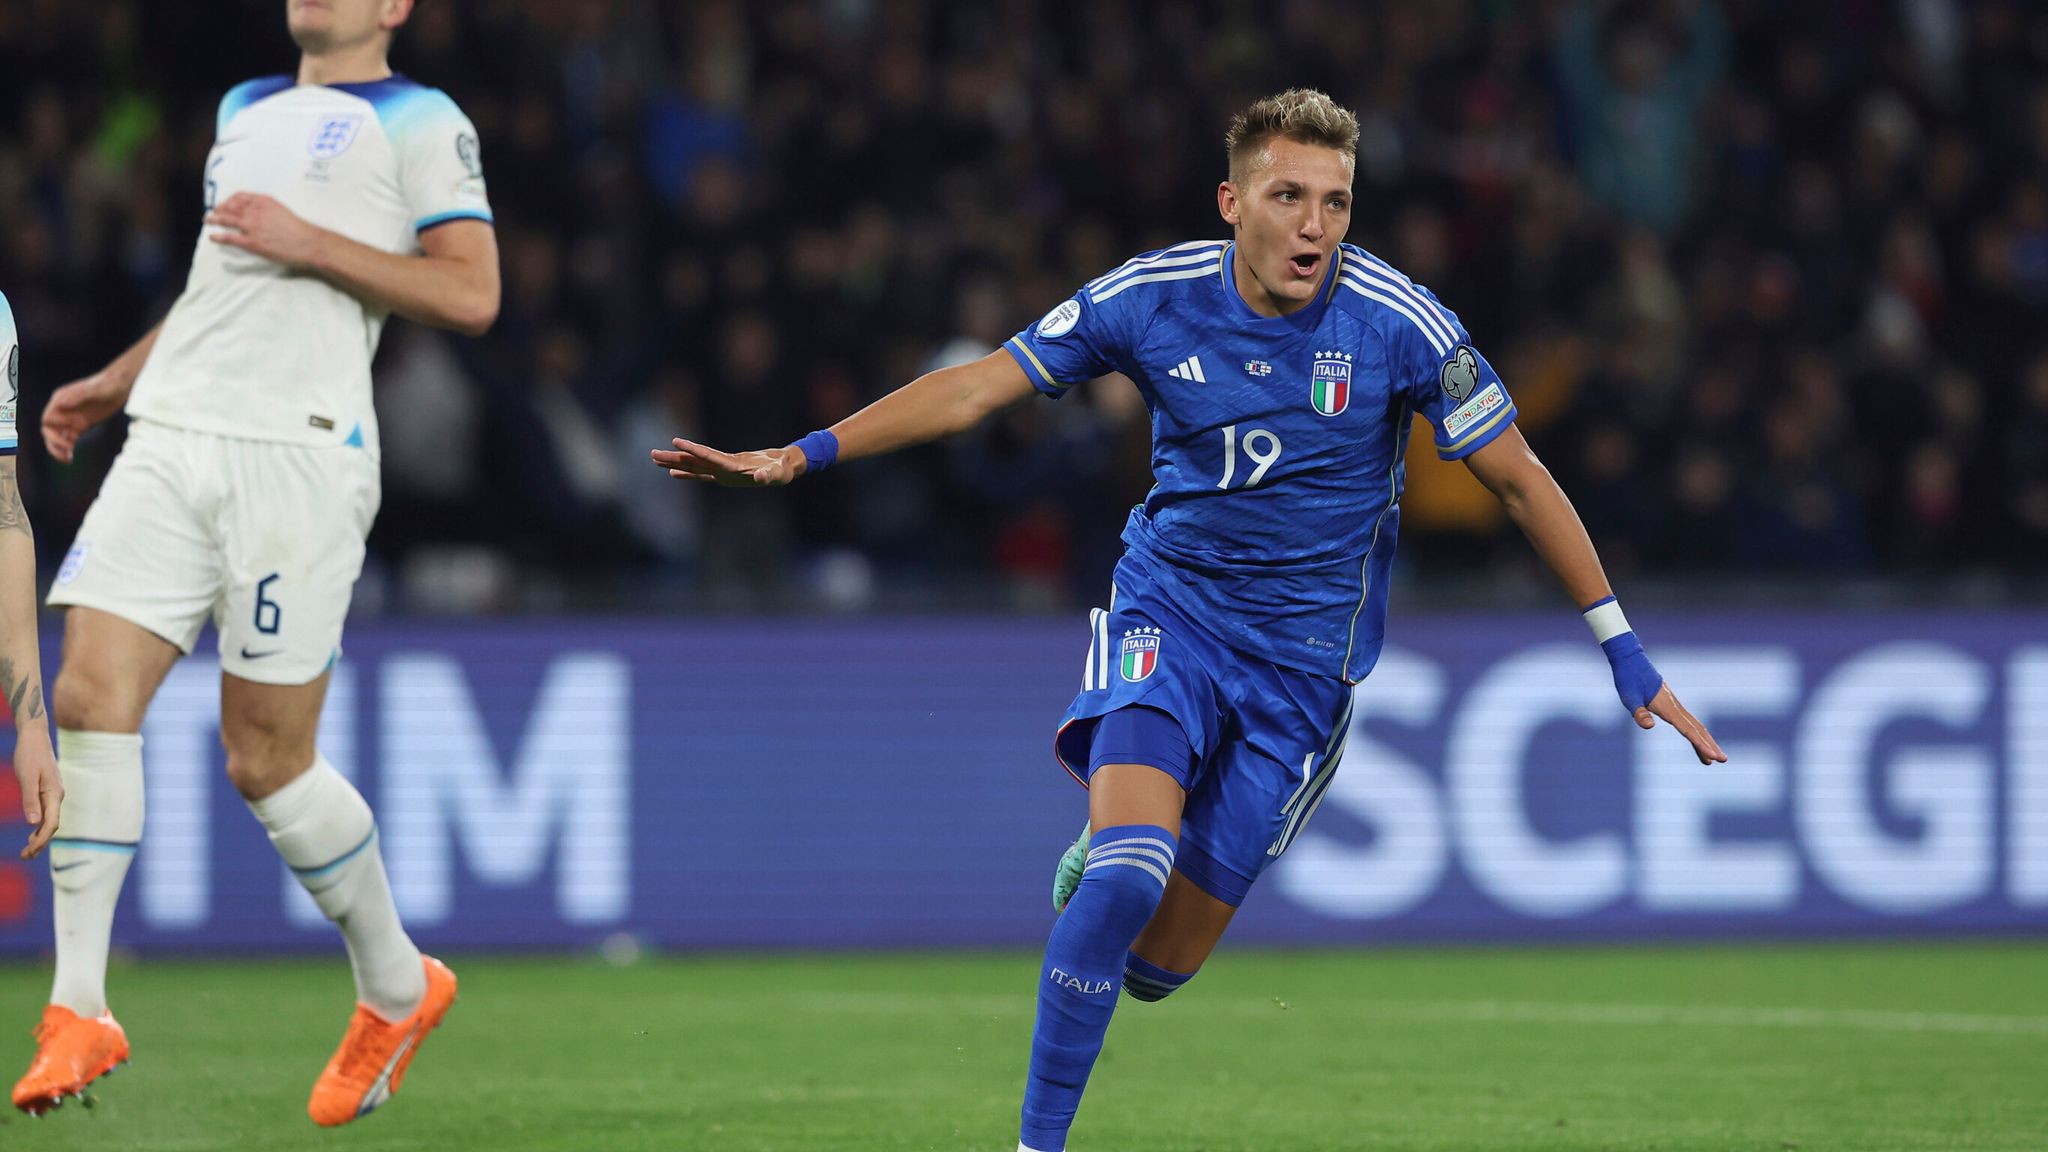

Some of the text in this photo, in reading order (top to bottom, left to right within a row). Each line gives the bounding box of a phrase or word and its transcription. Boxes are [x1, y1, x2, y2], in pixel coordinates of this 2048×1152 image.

[1315, 364, 1348, 378] ITALIA
[1446, 388, 1501, 431] FOUNDATION
[1216, 425, 1282, 490] 19
[254, 572, 282, 635] 6
[1124, 638, 1156, 651] ITALIA
[137, 651, 634, 930] TM
[1050, 967, 1112, 994] ITALIA
